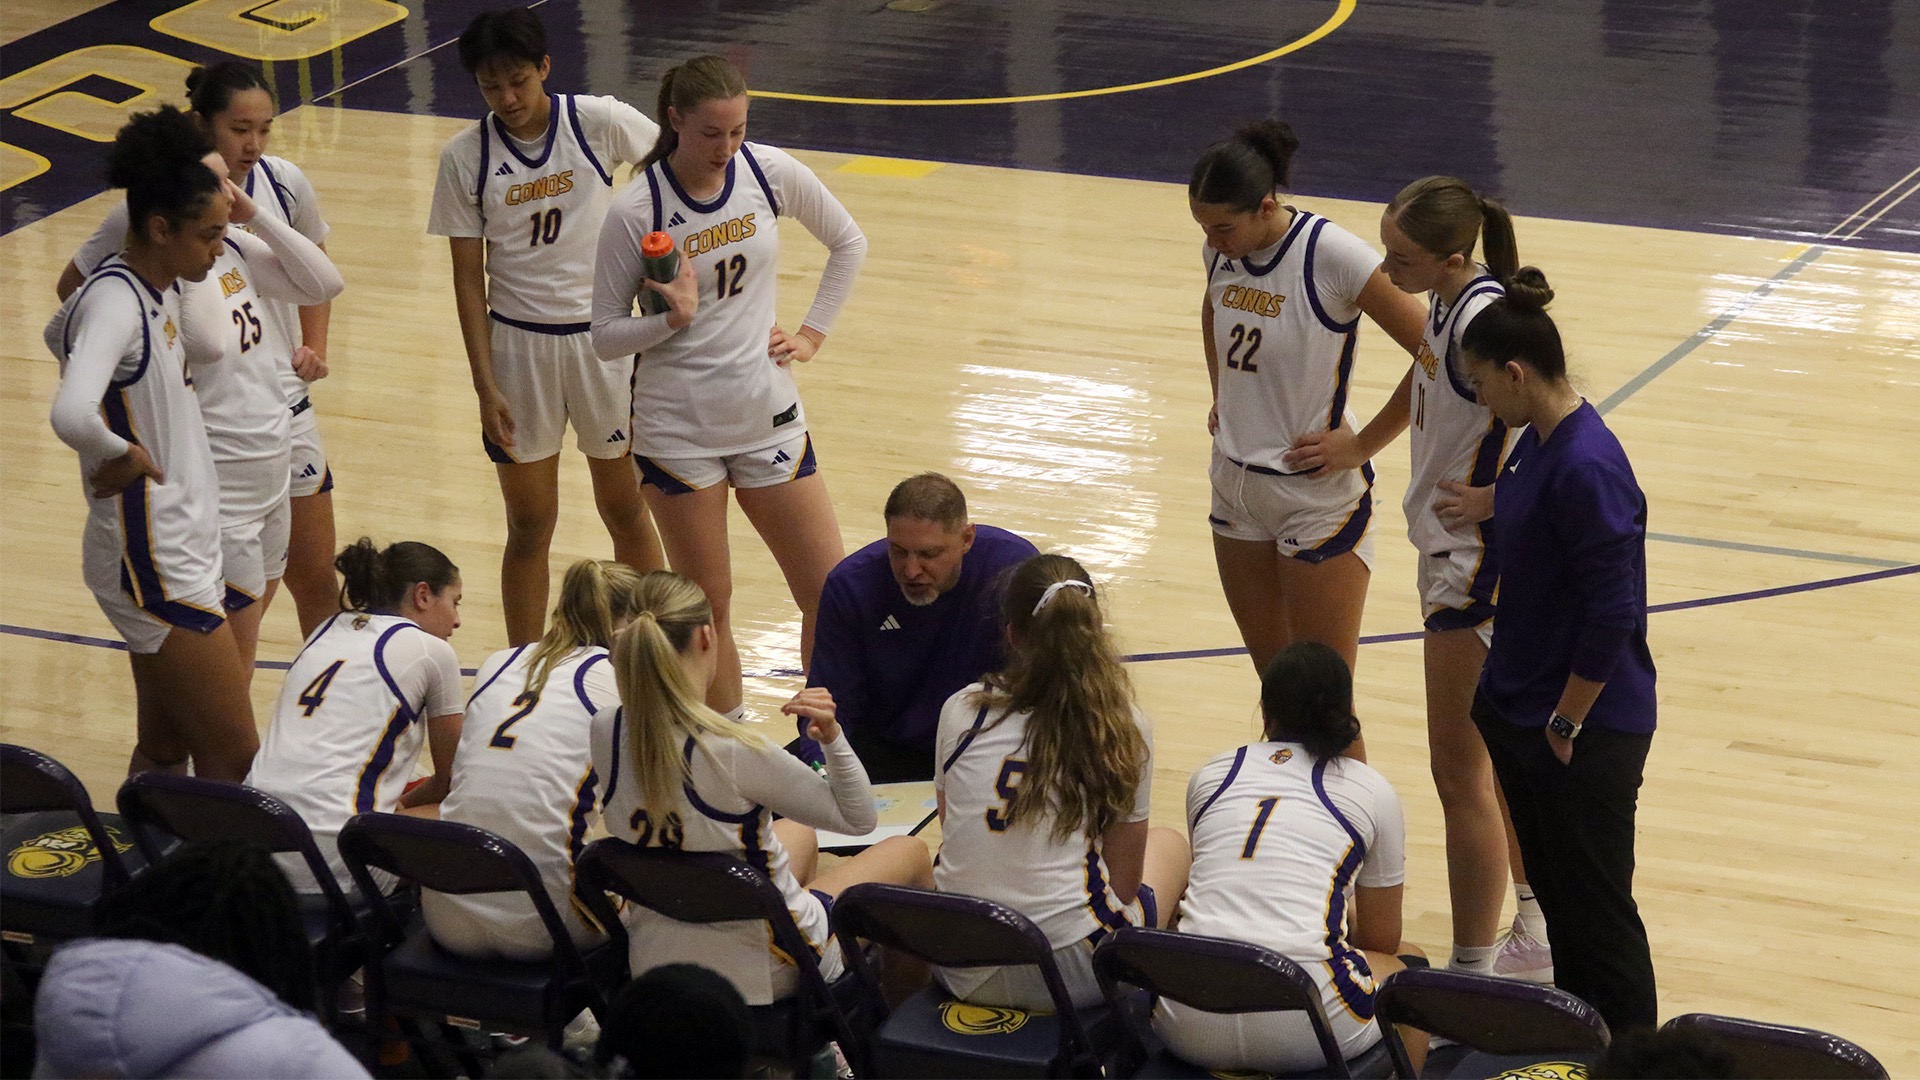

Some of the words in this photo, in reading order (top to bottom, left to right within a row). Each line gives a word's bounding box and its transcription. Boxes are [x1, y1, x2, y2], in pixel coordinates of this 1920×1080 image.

[505, 169, 574, 206] CONQS
[529, 206, 563, 247] 10
[683, 213, 757, 259] CONQS
[714, 252, 747, 301] 12
[1221, 284, 1287, 319] CONQS
[231, 300, 262, 354] 25
[1226, 322, 1263, 374] 22
[297, 659, 348, 718] 4
[487, 690, 543, 751] 2
[984, 755, 1030, 834] 5
[1239, 795, 1282, 861] 1
